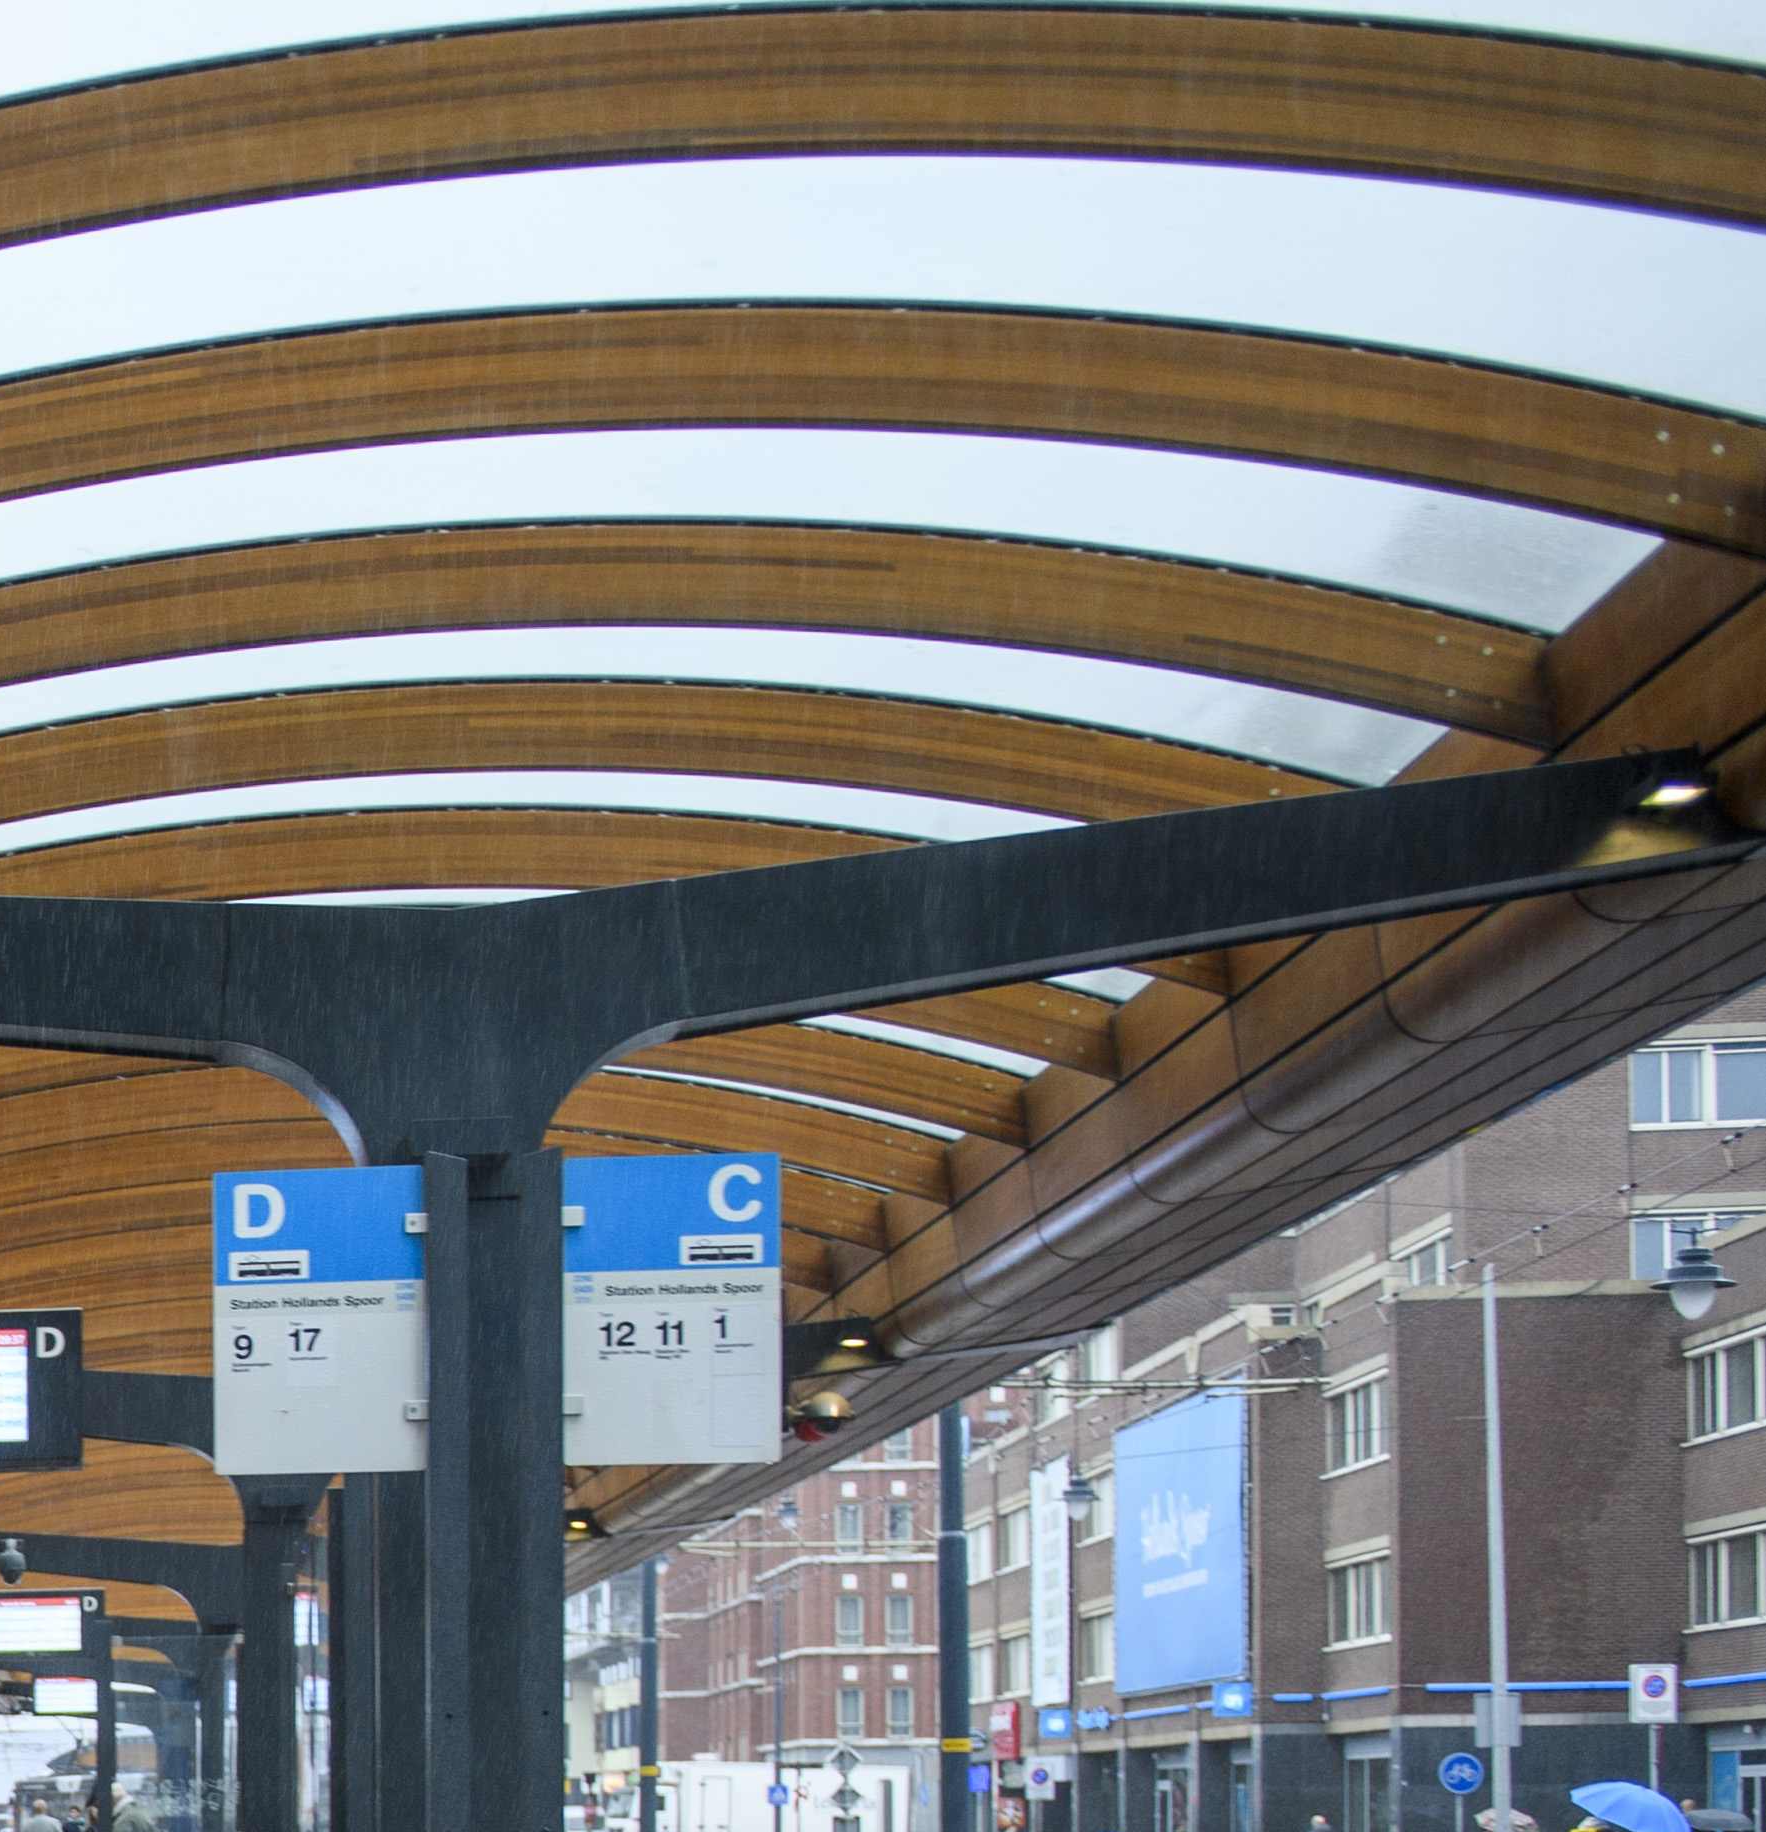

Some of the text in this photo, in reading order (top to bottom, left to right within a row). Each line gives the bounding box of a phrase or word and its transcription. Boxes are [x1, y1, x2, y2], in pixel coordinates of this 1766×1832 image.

[708, 1163, 763, 1222] C
[233, 1183, 286, 1239] D
[605, 1282, 764, 1297] Station Hollands Spoor
[230, 1299, 279, 1310] Station
[281, 1297, 340, 1308] Hollands
[343, 1295, 385, 1309] Spoor
[599, 1321, 636, 1347] 12
[655, 1320, 684, 1345] 11
[714, 1314, 727, 1339] 1
[35, 1326, 66, 1359] D
[233, 1334, 253, 1360] 9
[288, 1328, 322, 1352] 17
[82, 1595, 99, 1613] D
